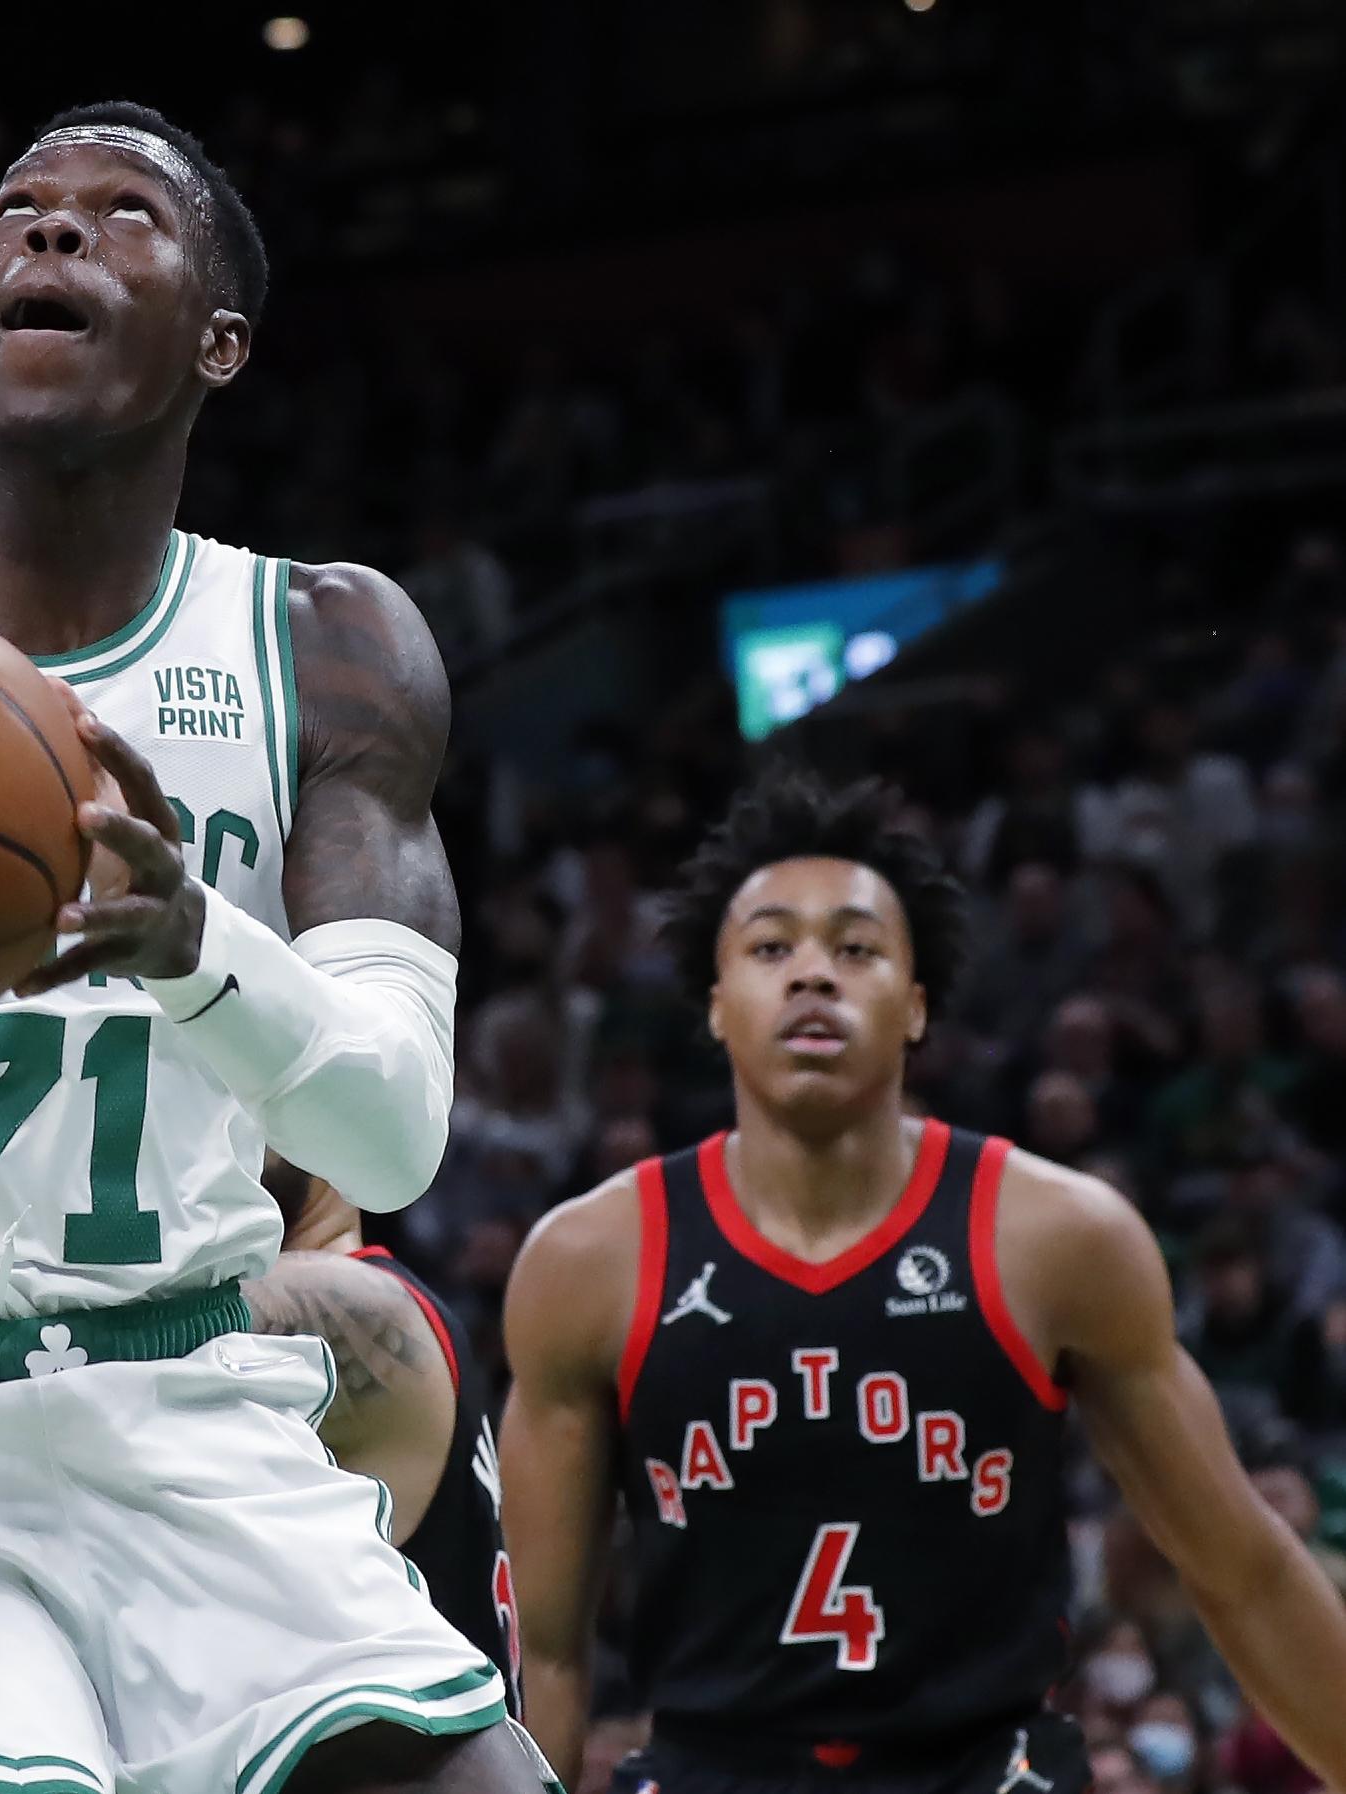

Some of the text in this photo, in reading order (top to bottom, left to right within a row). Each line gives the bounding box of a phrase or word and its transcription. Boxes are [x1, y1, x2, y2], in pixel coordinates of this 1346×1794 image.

[154, 667, 244, 710] VISTA
[158, 707, 245, 739] PRINT
[646, 1347, 1013, 1528] RAPTORS
[779, 1521, 885, 1671] 4
